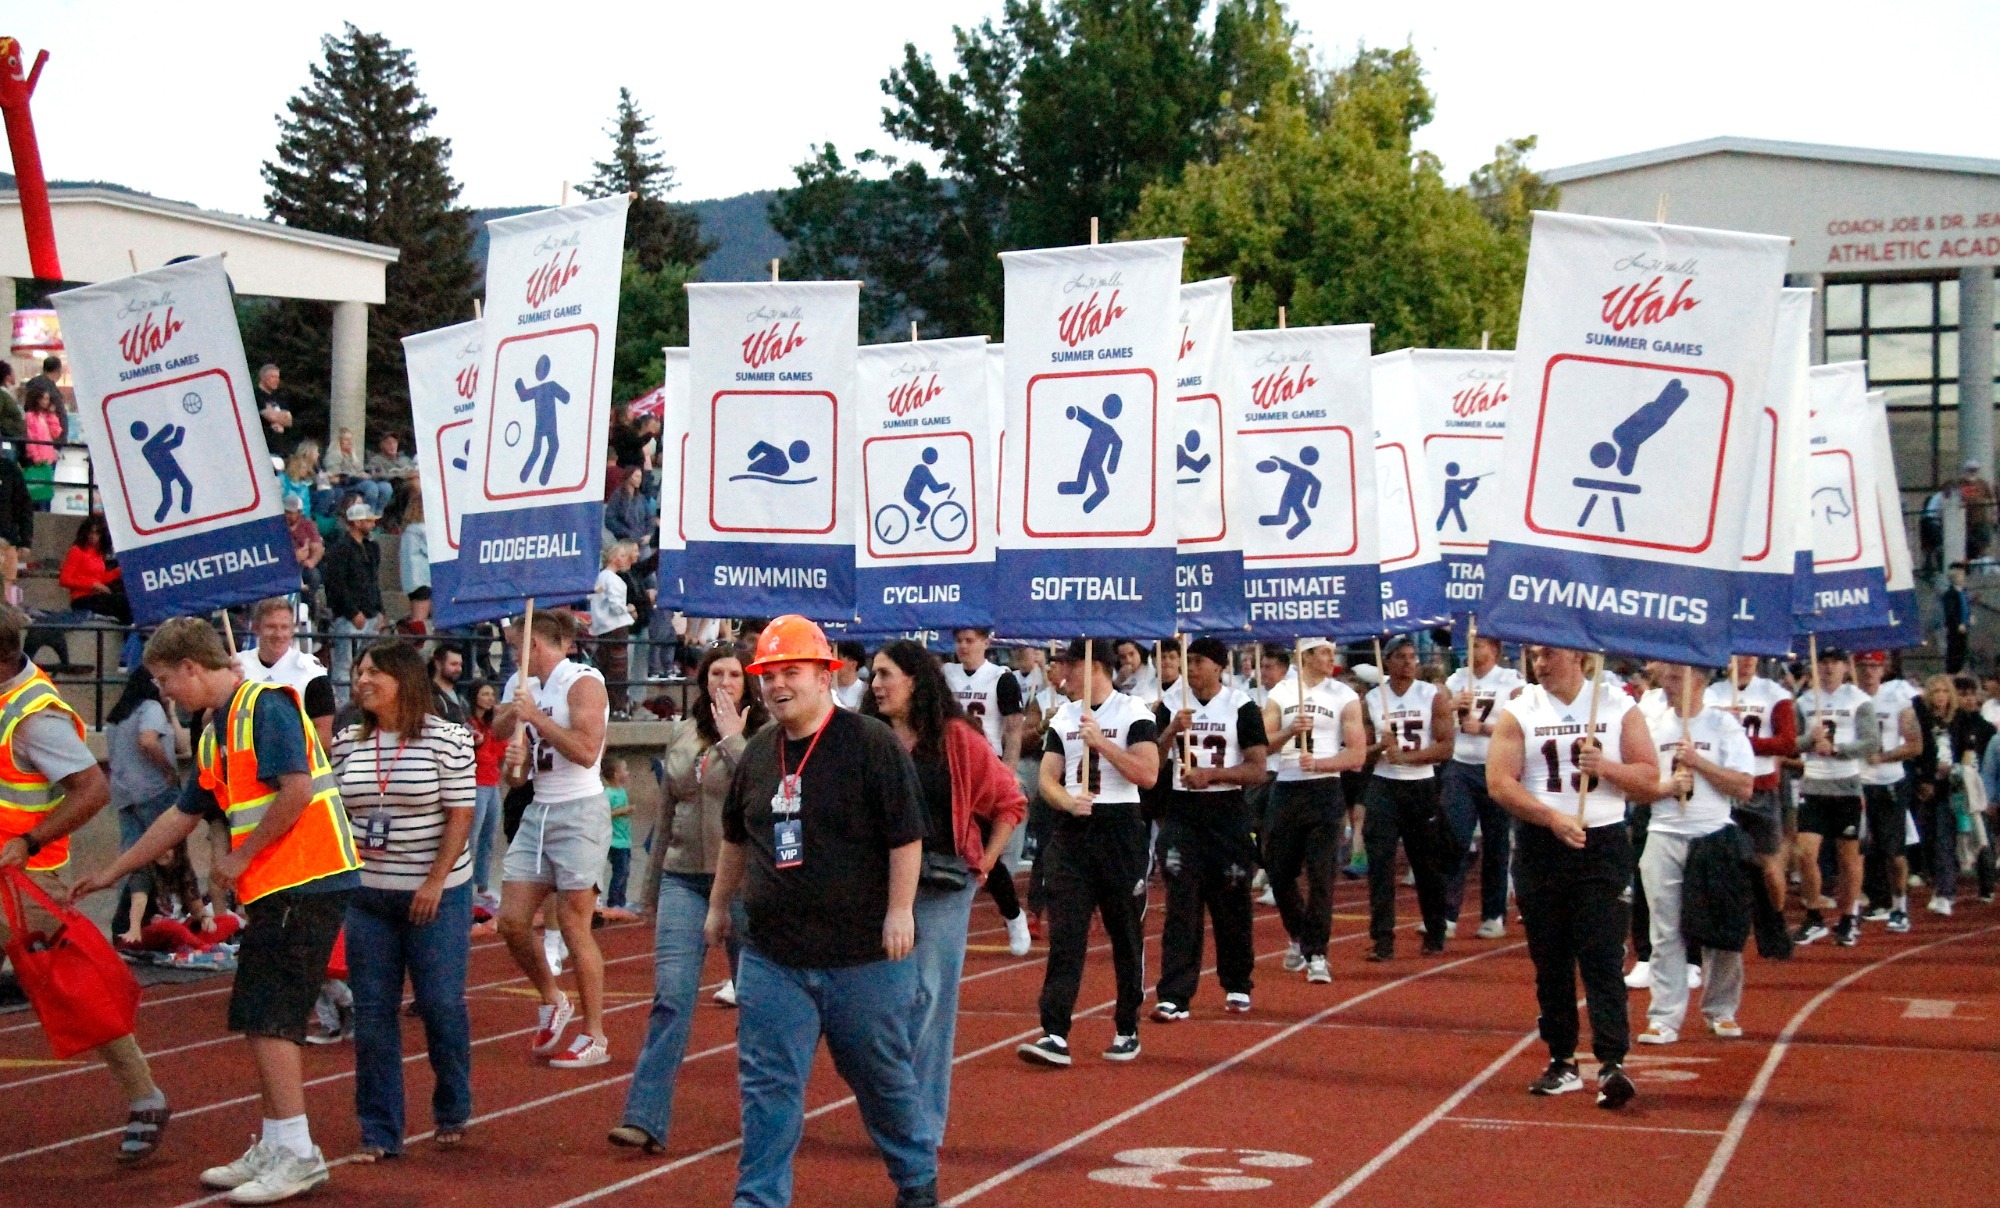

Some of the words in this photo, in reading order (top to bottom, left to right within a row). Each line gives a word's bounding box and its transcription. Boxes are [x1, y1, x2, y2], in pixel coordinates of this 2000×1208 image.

[1827, 219, 1884, 235] COACH
[1889, 216, 1920, 232] JOE
[1828, 240, 1930, 262] ATHLETIC
[526, 248, 582, 309] Utah
[518, 310, 551, 325] SUMMER
[553, 304, 582, 318] GAMES
[1602, 276, 1701, 331] Utah
[1059, 289, 1127, 347] Utah
[119, 306, 184, 365] Utah
[742, 322, 807, 369] Utah
[1585, 332, 1647, 350] SUMMER
[1652, 340, 1703, 356] GAMES
[1051, 350, 1094, 363] SUMMER
[1098, 347, 1133, 360] GAMES
[119, 363, 163, 381] SUMMER
[165, 354, 200, 370] GAMES
[735, 372, 775, 381] SUMMER
[779, 372, 813, 381] GAMES
[888, 373, 945, 417] Utah
[1252, 364, 1320, 409] Utah
[883, 419, 919, 429] SUMMER
[921, 416, 951, 426] GAMES
[1245, 412, 1288, 421] SUMMER
[1292, 409, 1327, 419] GAMES
[479, 532, 582, 564] DODGEBALL
[142, 543, 280, 592] BASKETBALL
[714, 565, 828, 589] SWIMMING
[1202, 564, 1213, 586] &
[883, 584, 960, 605] CYCLING
[1030, 577, 1143, 601] SOFTBALL
[1244, 576, 1346, 598] ULTIMATE
[1250, 599, 1340, 621] FRISBEE
[1508, 574, 1709, 625] GYMNASTICS
[780, 849, 798, 861] VIP
